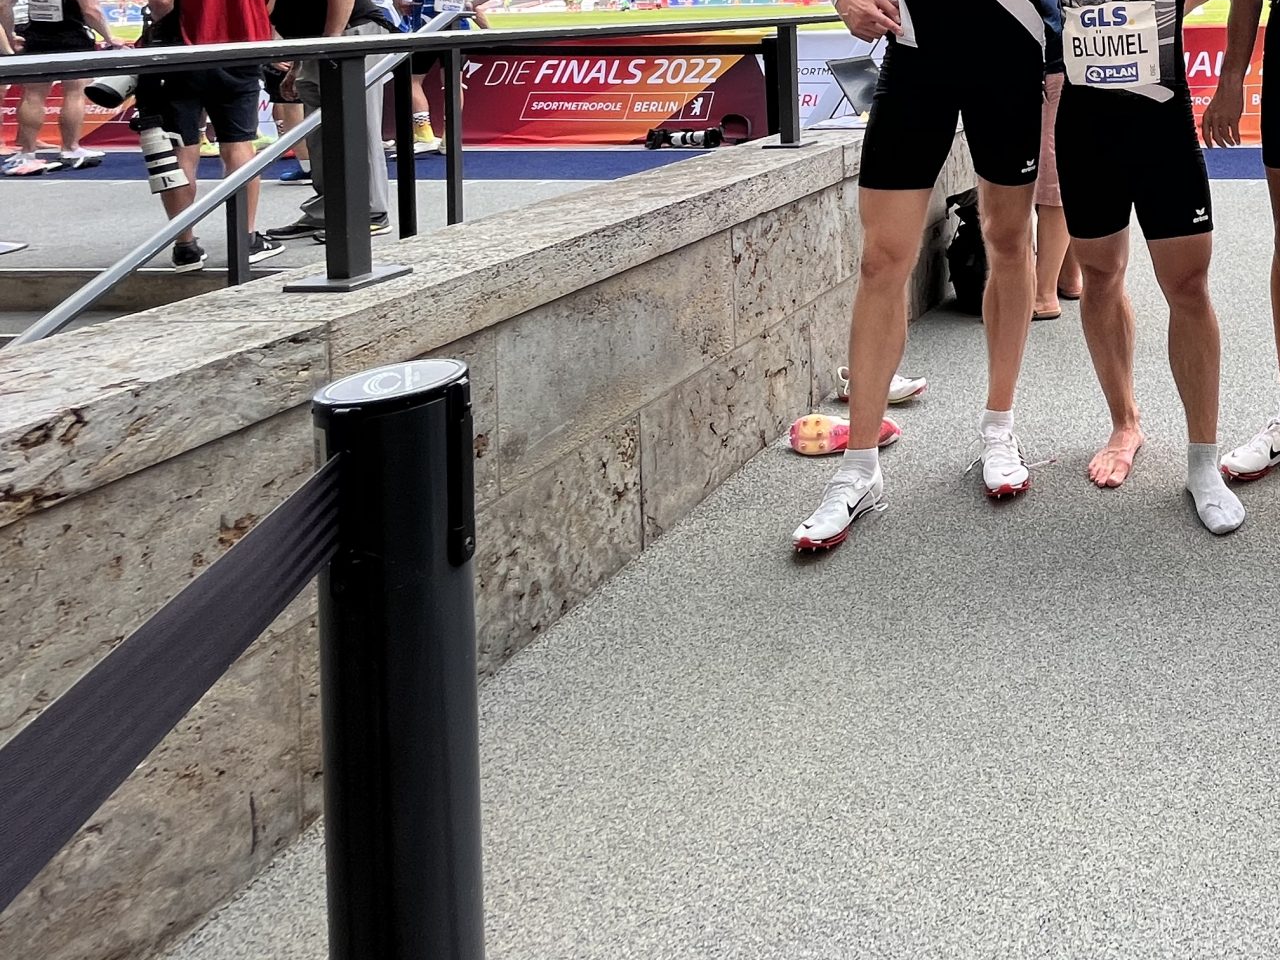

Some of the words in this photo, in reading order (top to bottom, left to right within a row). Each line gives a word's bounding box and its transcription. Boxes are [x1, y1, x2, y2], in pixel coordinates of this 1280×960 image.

[1072, 30, 1149, 57] BLÜMEL
[484, 60, 535, 86] DIE
[533, 58, 646, 85] FINALS
[646, 58, 722, 85] 2022
[1105, 66, 1137, 77] PLAN
[531, 101, 622, 111] SPORTMETROPOLE
[633, 101, 679, 113] BERLIN
